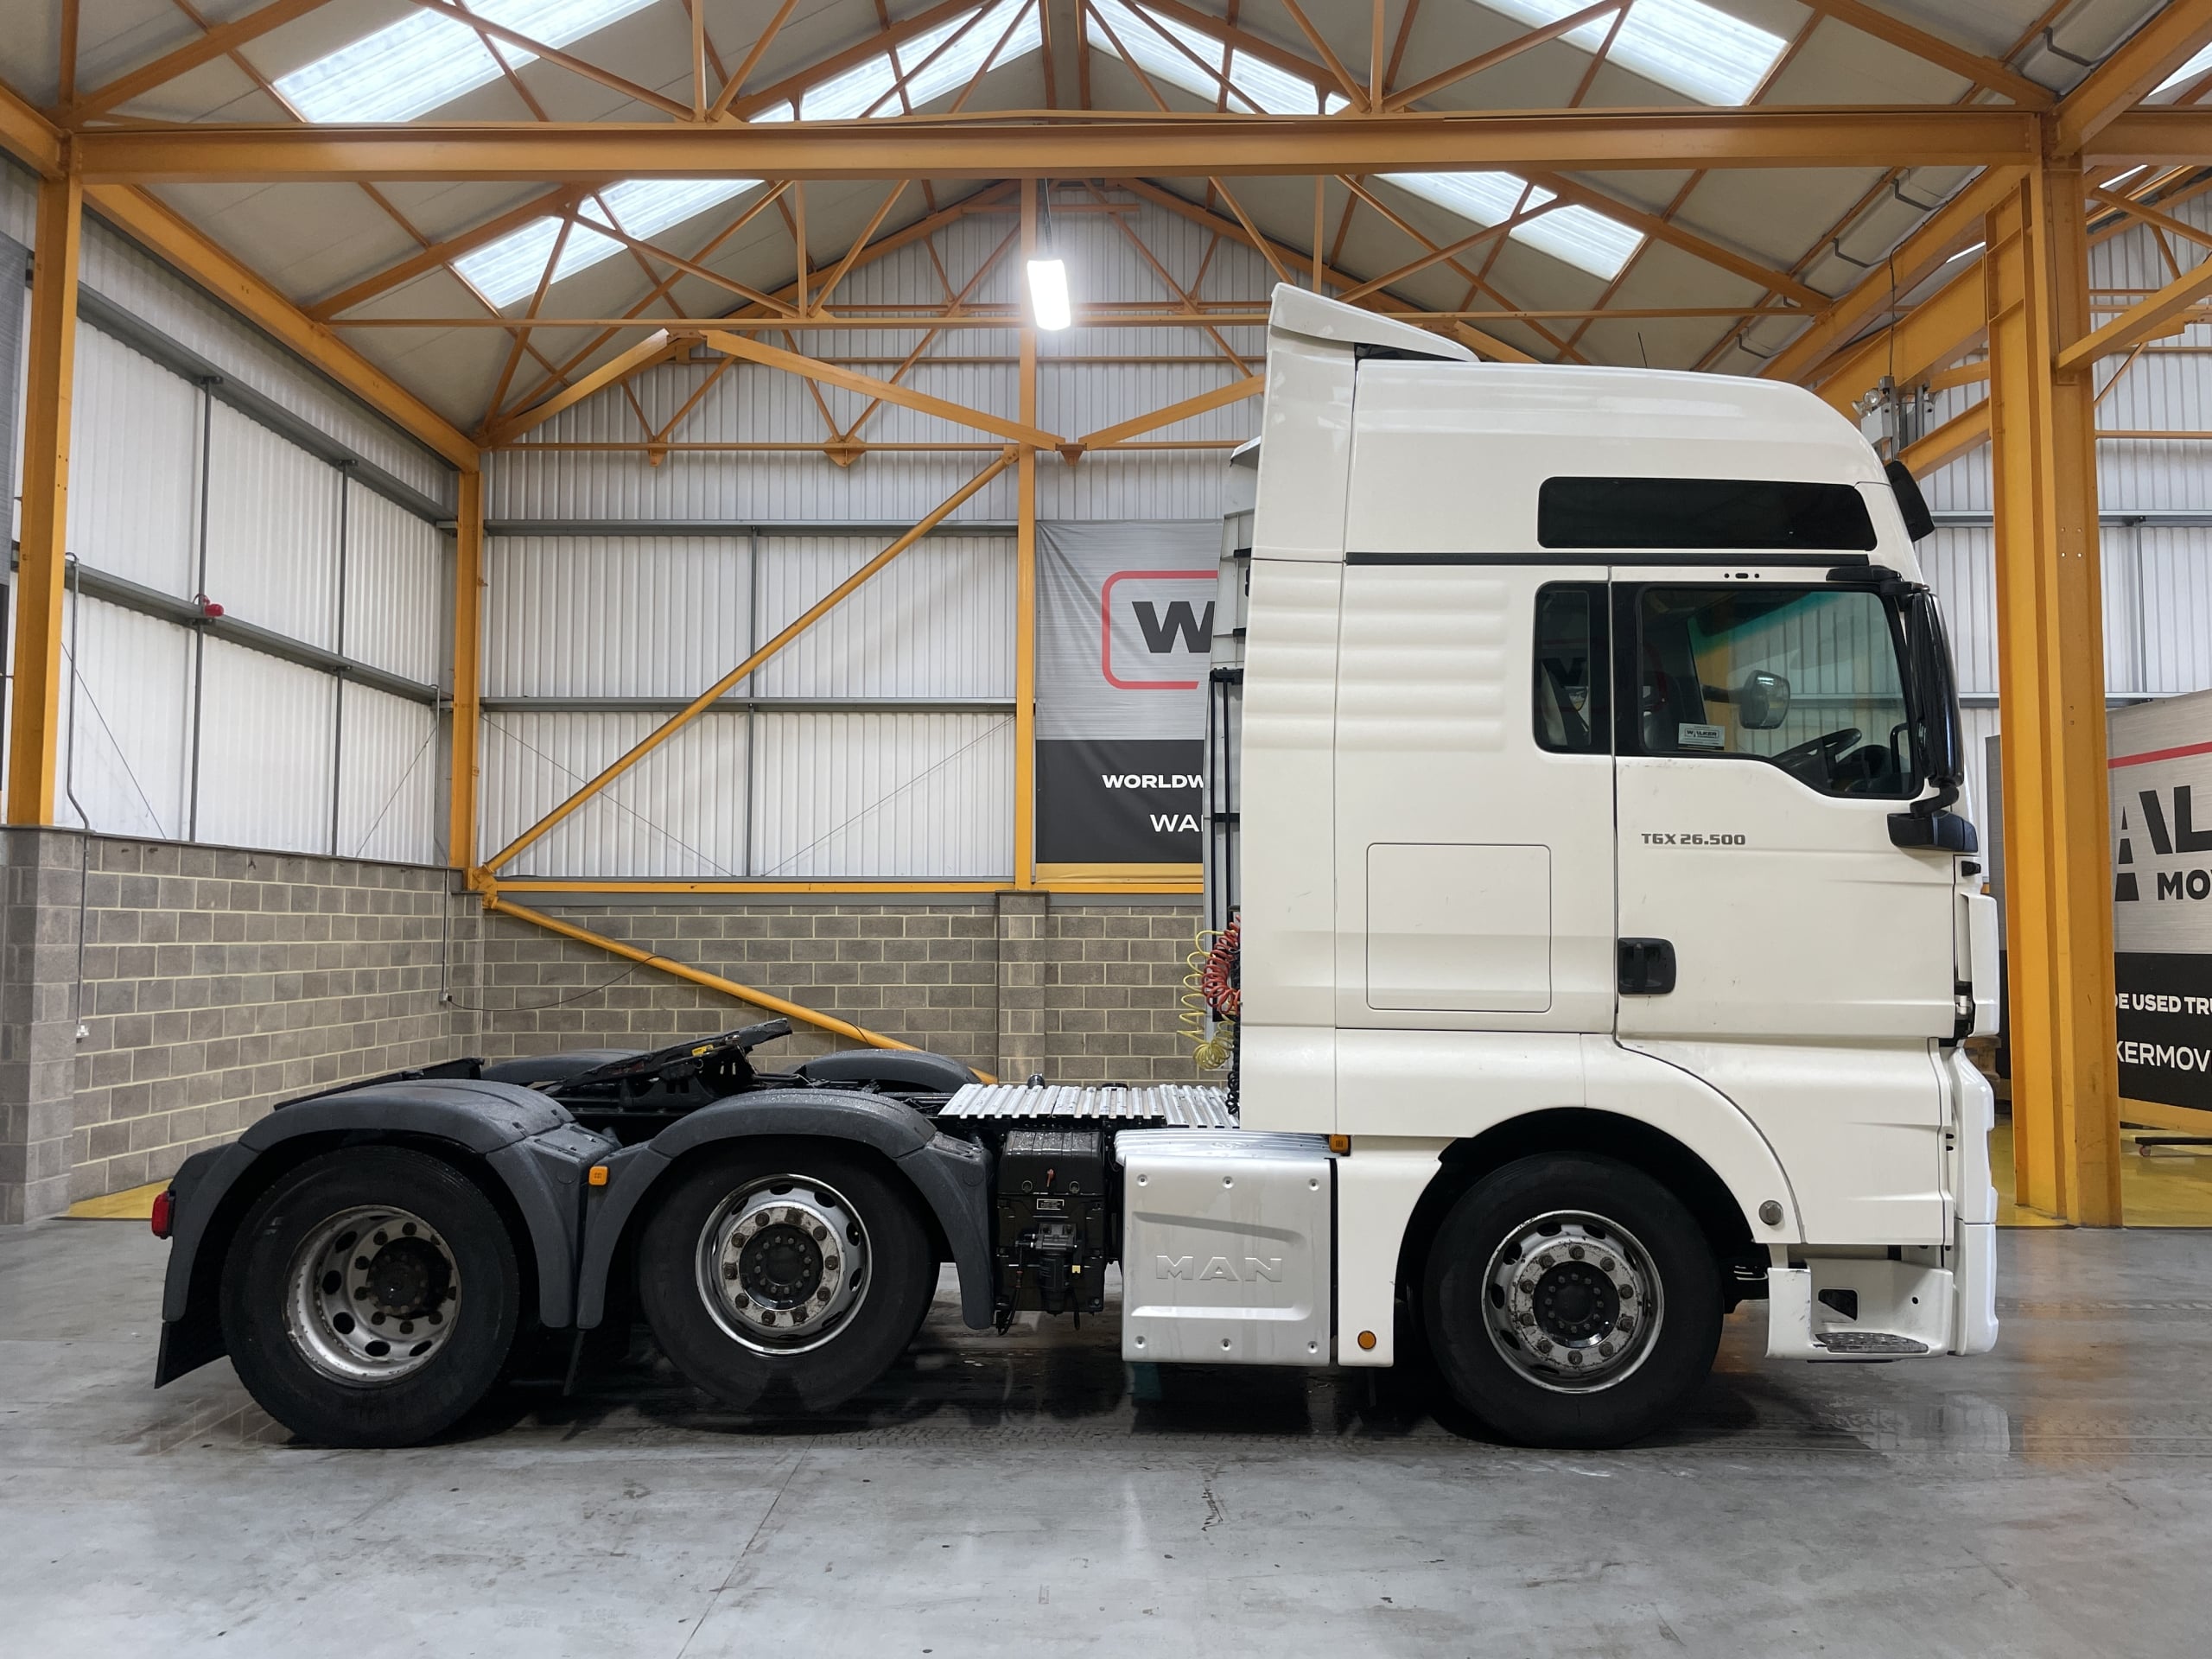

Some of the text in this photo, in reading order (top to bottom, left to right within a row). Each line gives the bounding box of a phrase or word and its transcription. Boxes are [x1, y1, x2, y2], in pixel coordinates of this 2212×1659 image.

[1131, 601, 1216, 653] W
[1149, 814, 1204, 833] WA
[1641, 833, 1746, 846] TGX 26.500
[2157, 869, 2212, 900] MO
[2132, 994, 2182, 1013] USED
[2183, 996, 2212, 1015] TR
[1156, 1255, 1282, 1282] MAN
